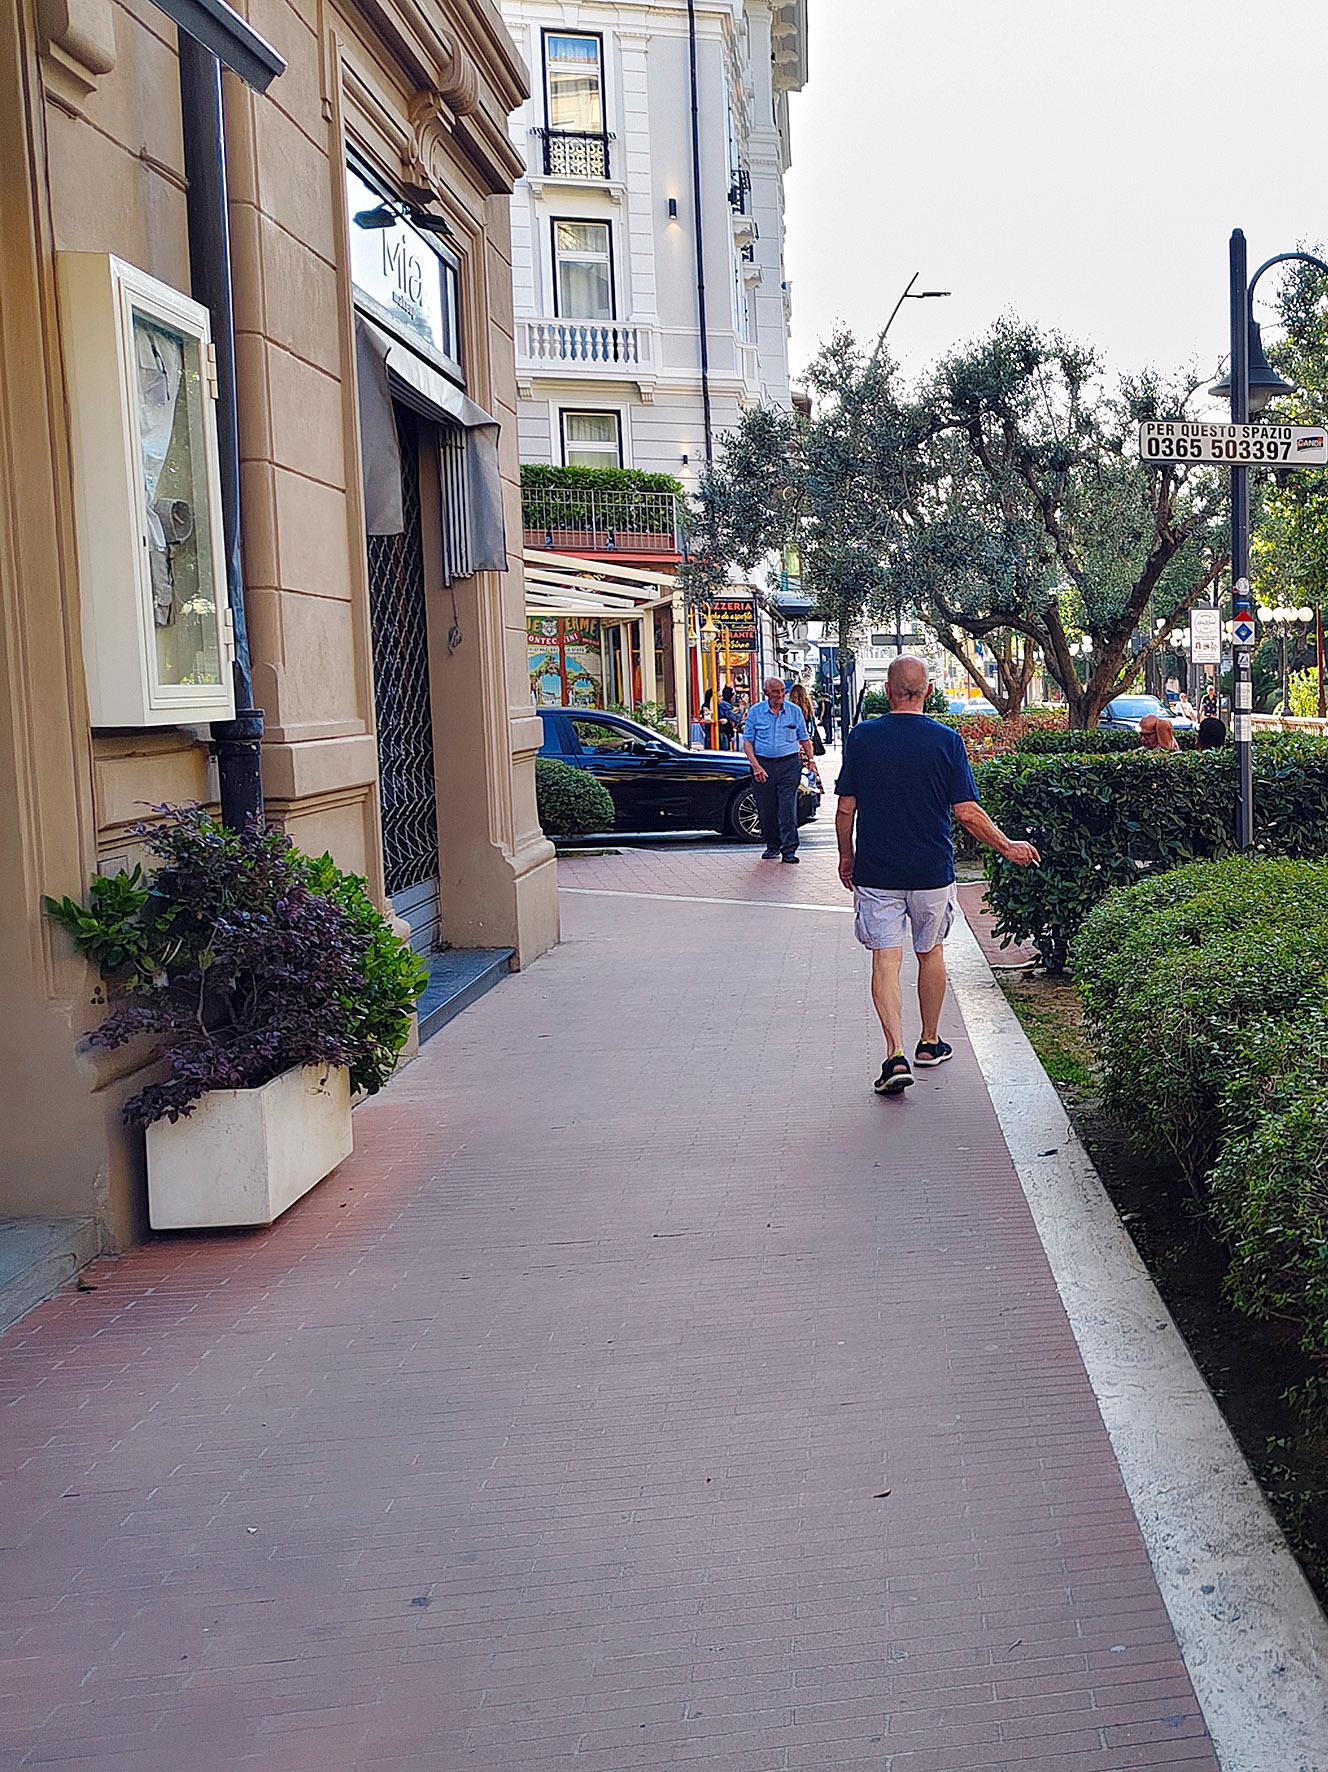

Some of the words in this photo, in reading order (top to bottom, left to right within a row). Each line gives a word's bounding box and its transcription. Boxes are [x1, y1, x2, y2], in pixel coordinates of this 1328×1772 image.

[382, 228, 423, 307] Mia
[1147, 423, 1175, 436] PER
[1181, 425, 1236, 438] QUESTO
[1242, 427, 1292, 440] SPAZIO
[1147, 437, 1202, 458] 0365
[1211, 440, 1292, 461] 503397
